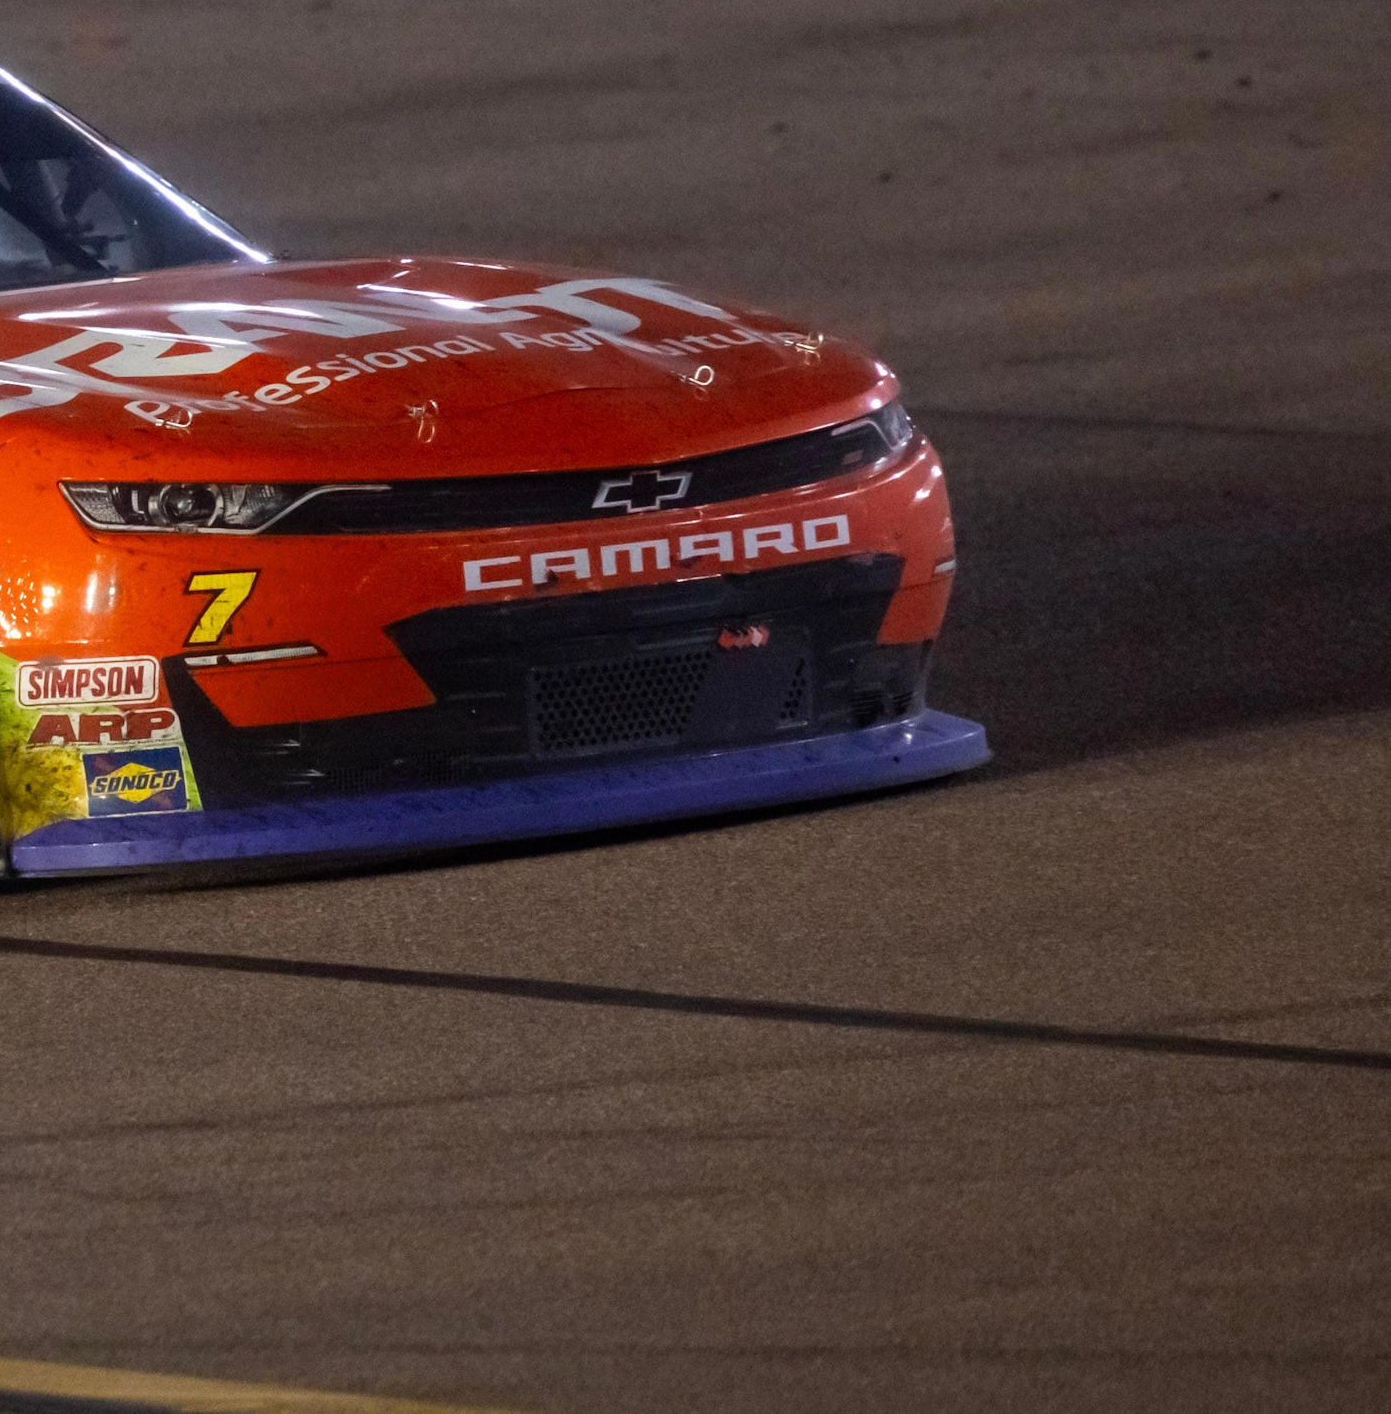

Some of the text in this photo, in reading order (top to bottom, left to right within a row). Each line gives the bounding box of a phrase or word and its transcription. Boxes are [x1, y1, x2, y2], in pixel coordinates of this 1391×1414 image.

[463, 514, 851, 592] CAMARO
[185, 570, 261, 648] 7
[27, 665, 145, 700] SIMPSON
[27, 710, 176, 745] ARP
[95, 771, 178, 794] SONOCO
